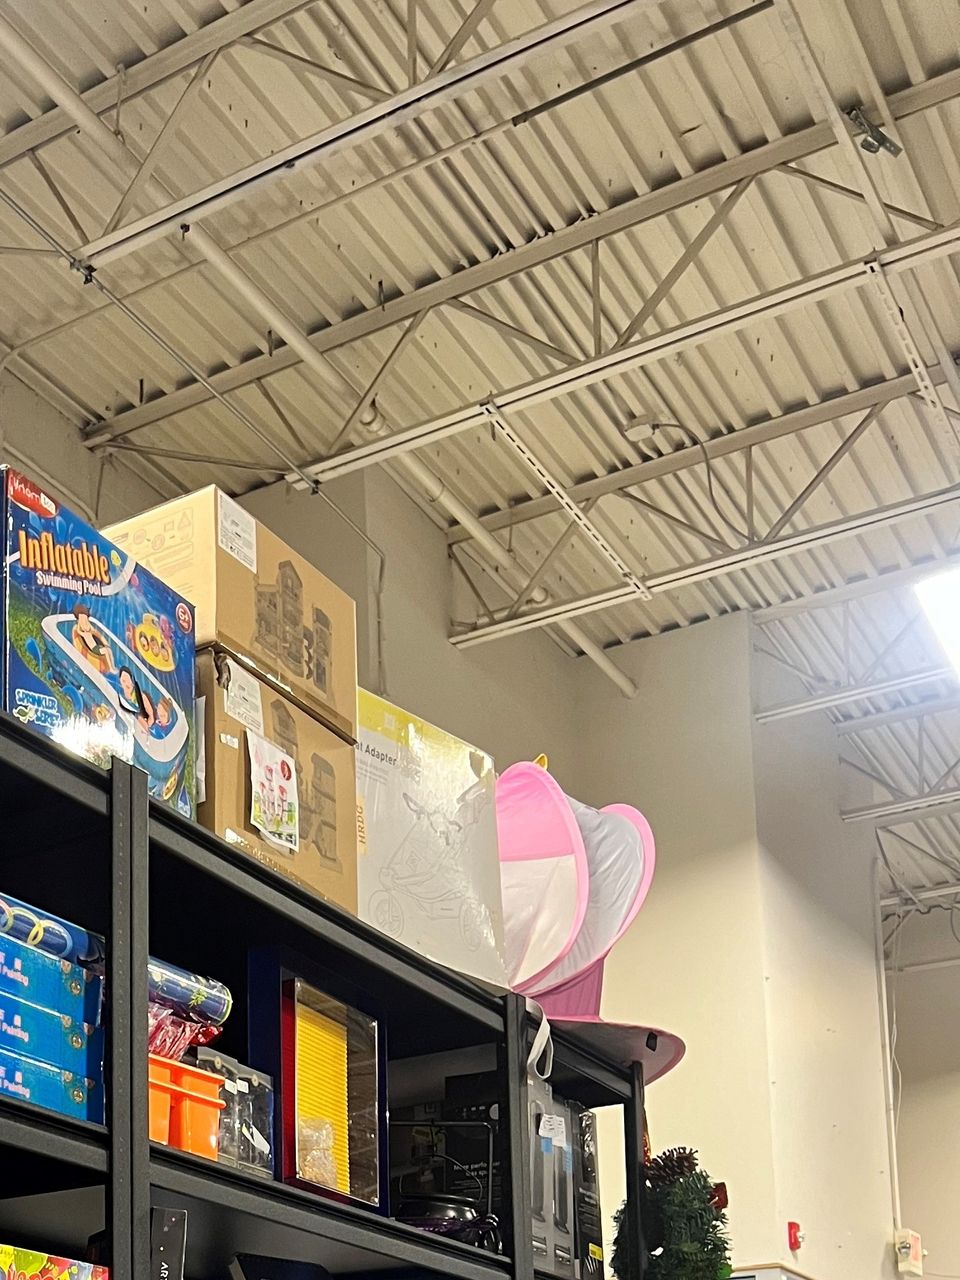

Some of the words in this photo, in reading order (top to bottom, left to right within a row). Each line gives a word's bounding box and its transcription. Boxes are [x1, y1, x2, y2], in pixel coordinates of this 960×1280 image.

[18, 530, 111, 586] Inflatable
[35, 570, 82, 594] Swimming
[83, 580, 102, 596] Pool
[16, 690, 57, 711] SPRINKLER
[365, 744, 397, 767] Adapter
